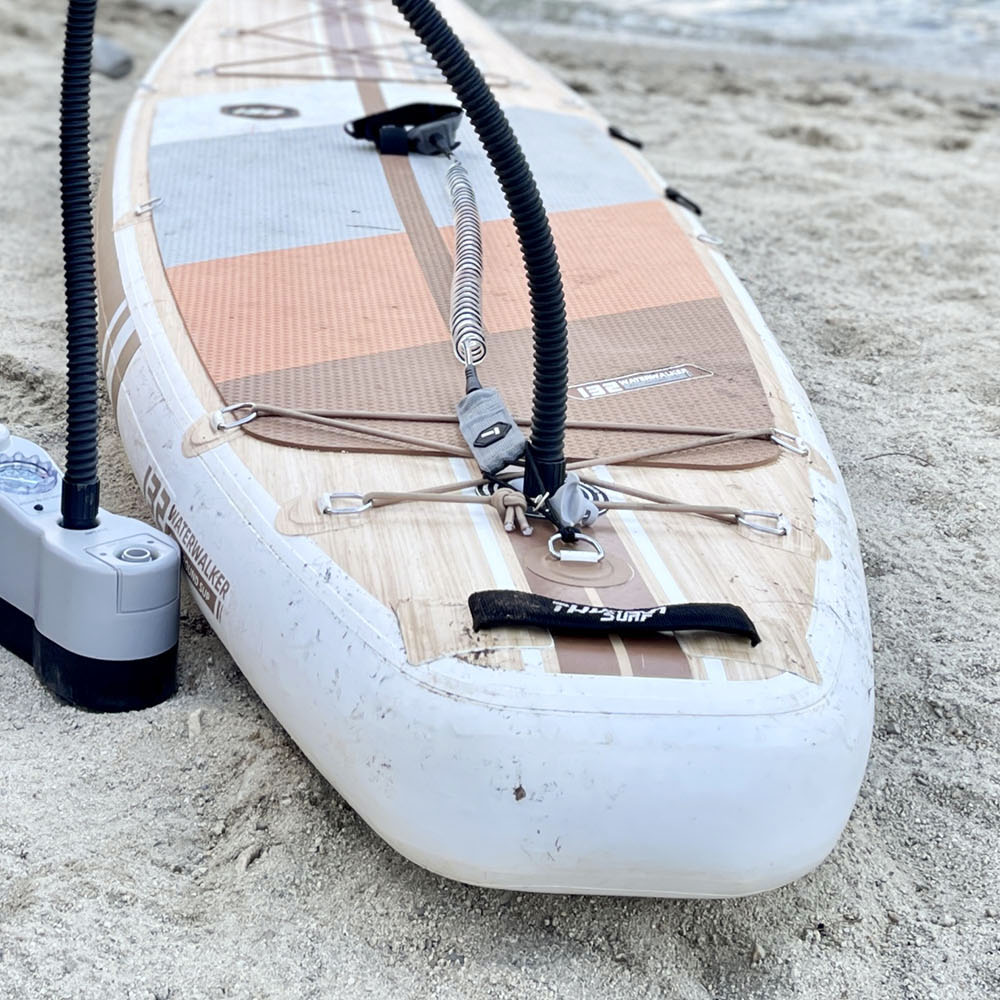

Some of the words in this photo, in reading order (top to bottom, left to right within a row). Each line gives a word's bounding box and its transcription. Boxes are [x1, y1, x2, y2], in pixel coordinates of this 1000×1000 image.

[577, 381, 623, 399] 132
[618, 368, 690, 387] WATERWALKER
[167, 504, 231, 598] WATERWALKER
[600, 608, 656, 622] SURF
